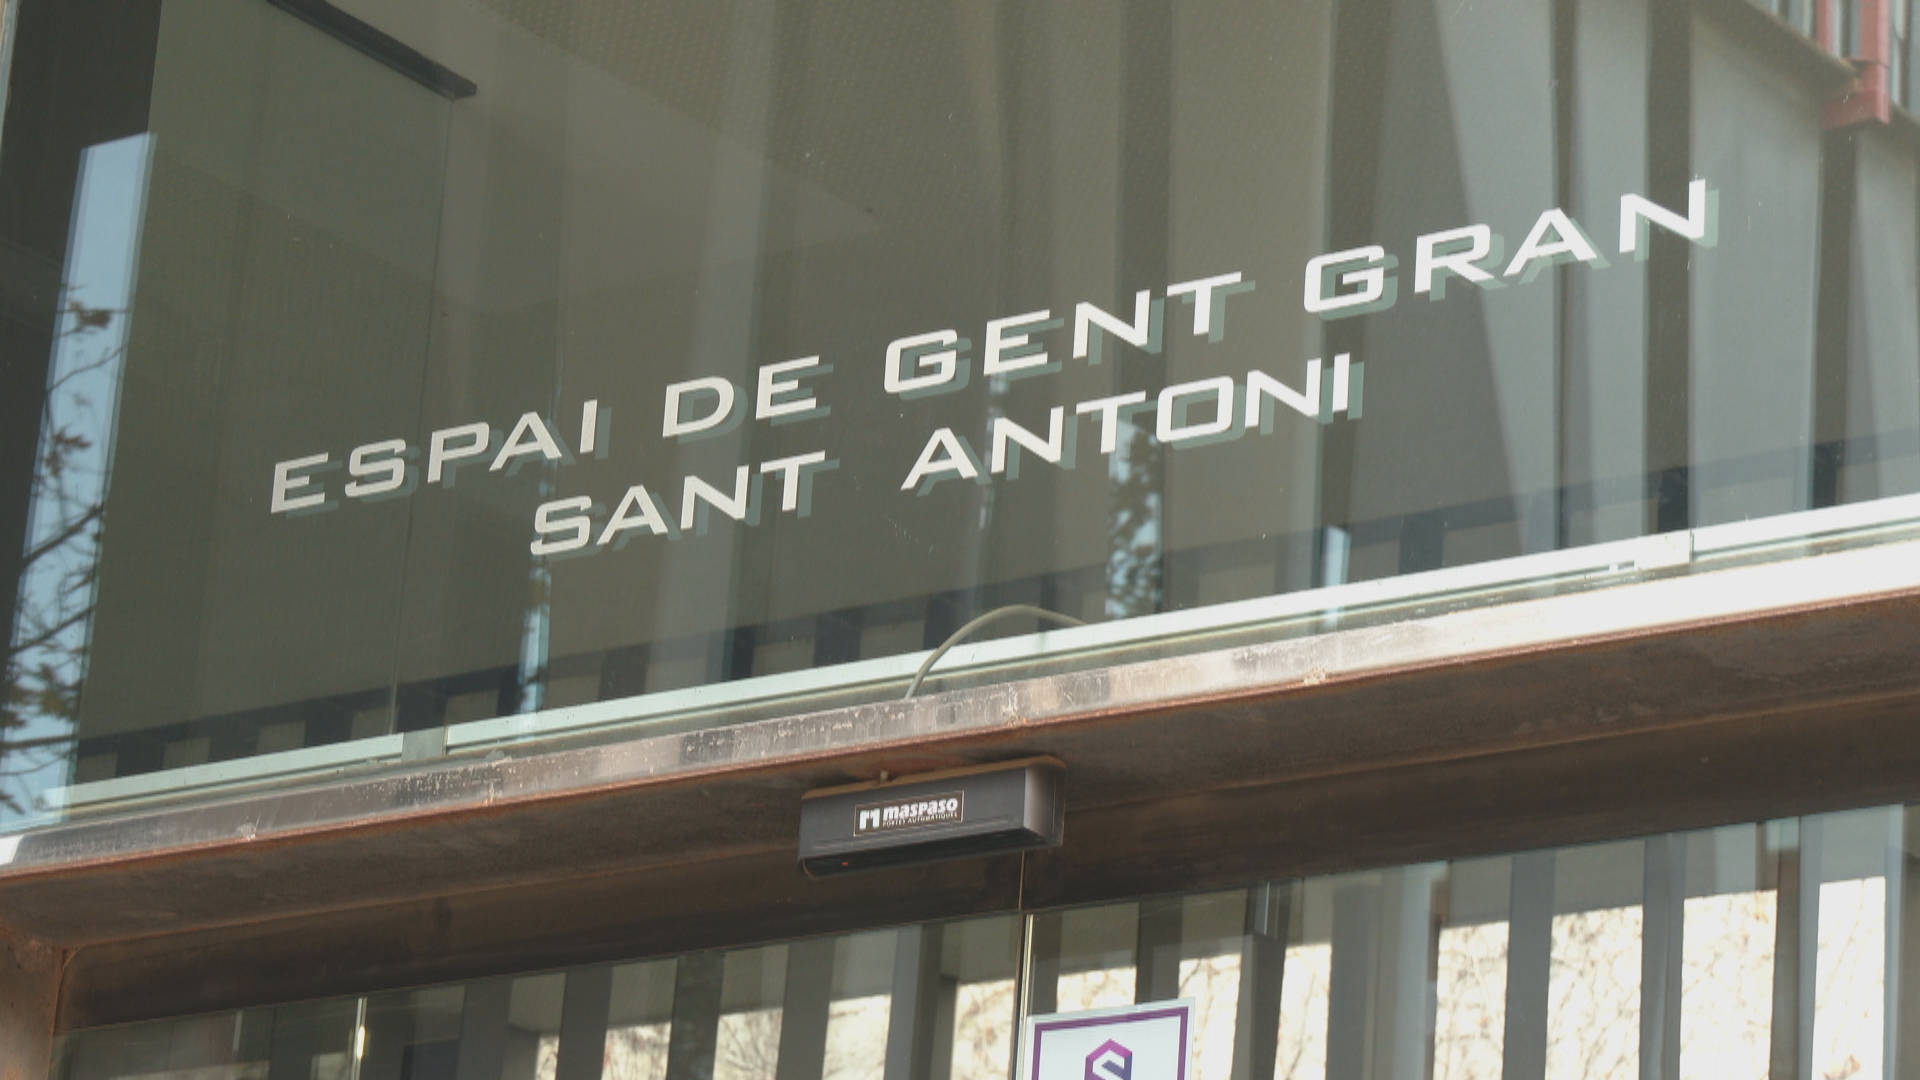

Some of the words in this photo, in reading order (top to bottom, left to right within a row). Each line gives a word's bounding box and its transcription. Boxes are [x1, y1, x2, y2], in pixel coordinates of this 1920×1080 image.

[270, 400, 598, 514] ESPAI
[662, 355, 820, 438] DE
[884, 271, 1243, 394] GENT
[1303, 178, 1707, 313] GRAN
[530, 450, 826, 556] SANT
[900, 352, 1351, 490] ANTONI
